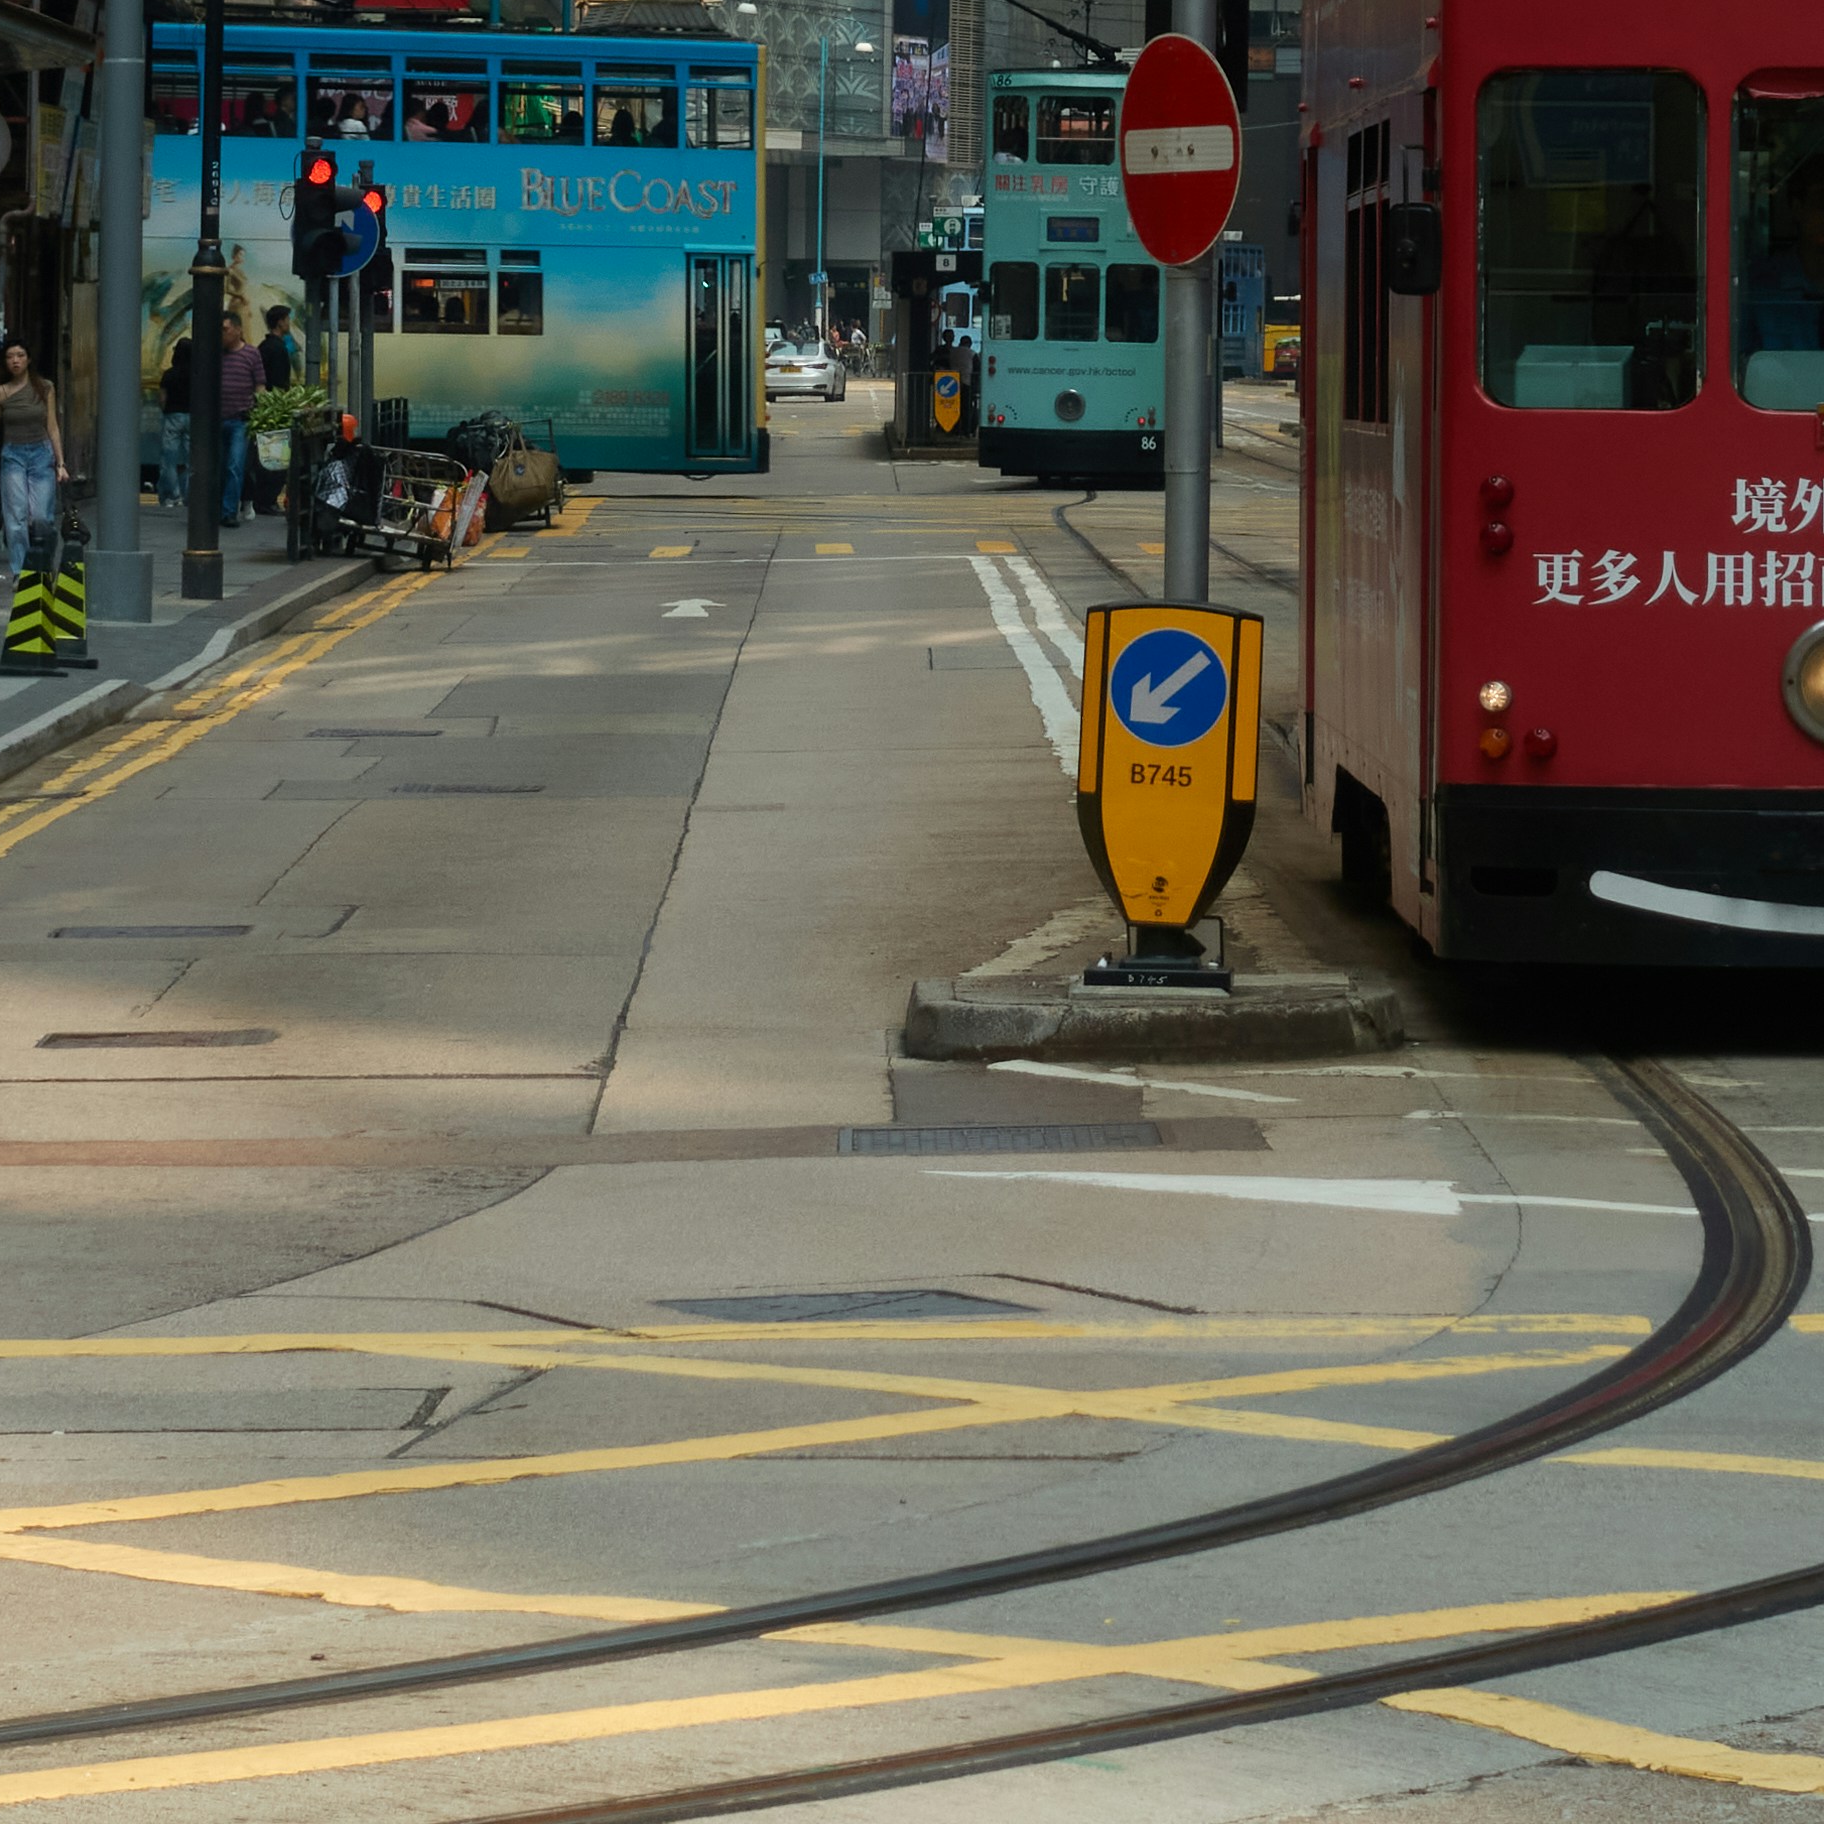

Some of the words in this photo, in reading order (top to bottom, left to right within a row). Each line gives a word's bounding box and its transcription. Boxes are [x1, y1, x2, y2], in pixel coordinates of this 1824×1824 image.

[996, 74, 1012, 87] 86
[943, 258, 950, 267] 8
[1141, 436, 1157, 450] 86
[1130, 762, 1193, 788] B745
